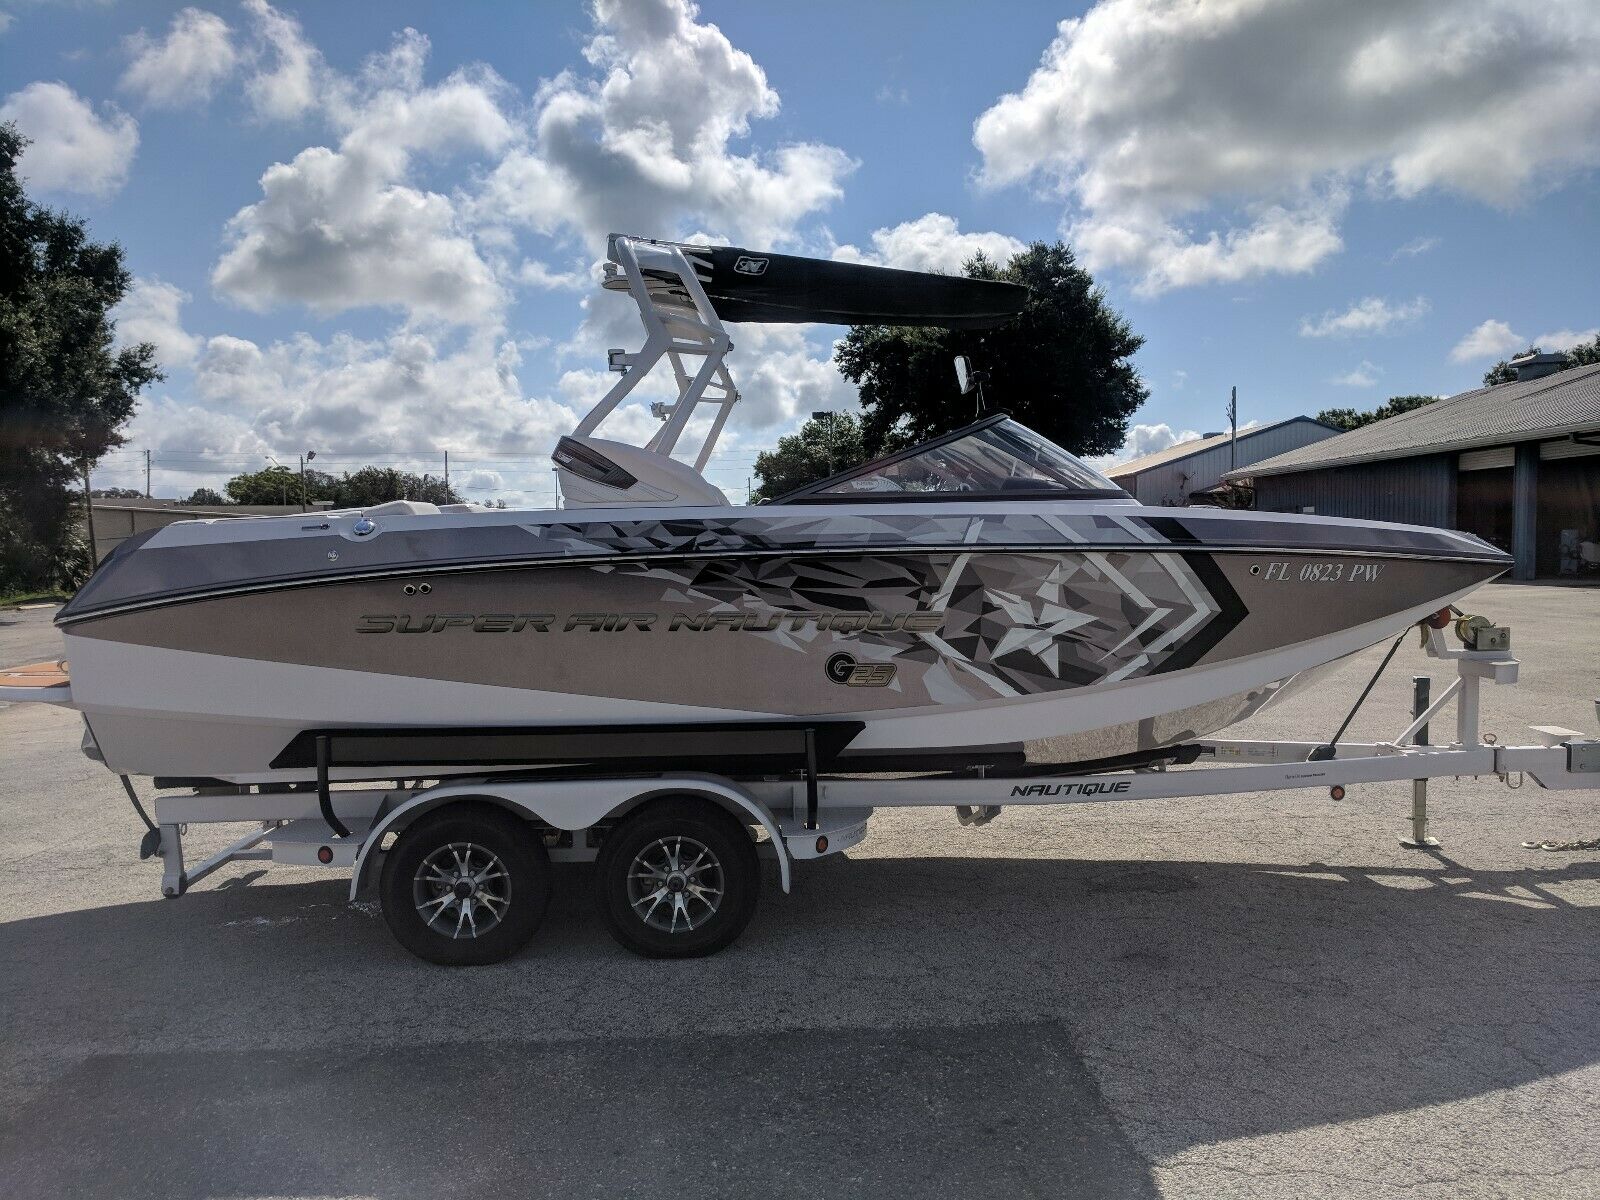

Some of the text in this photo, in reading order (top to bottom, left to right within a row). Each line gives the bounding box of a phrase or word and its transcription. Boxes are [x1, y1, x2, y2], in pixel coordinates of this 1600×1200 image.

[1264, 562, 1385, 582] FL 0823 PW
[355, 610, 945, 635] SUPER AIR NAUTIQUE
[825, 651, 897, 687] G23
[1010, 781, 1132, 797] NAUTIQUE
